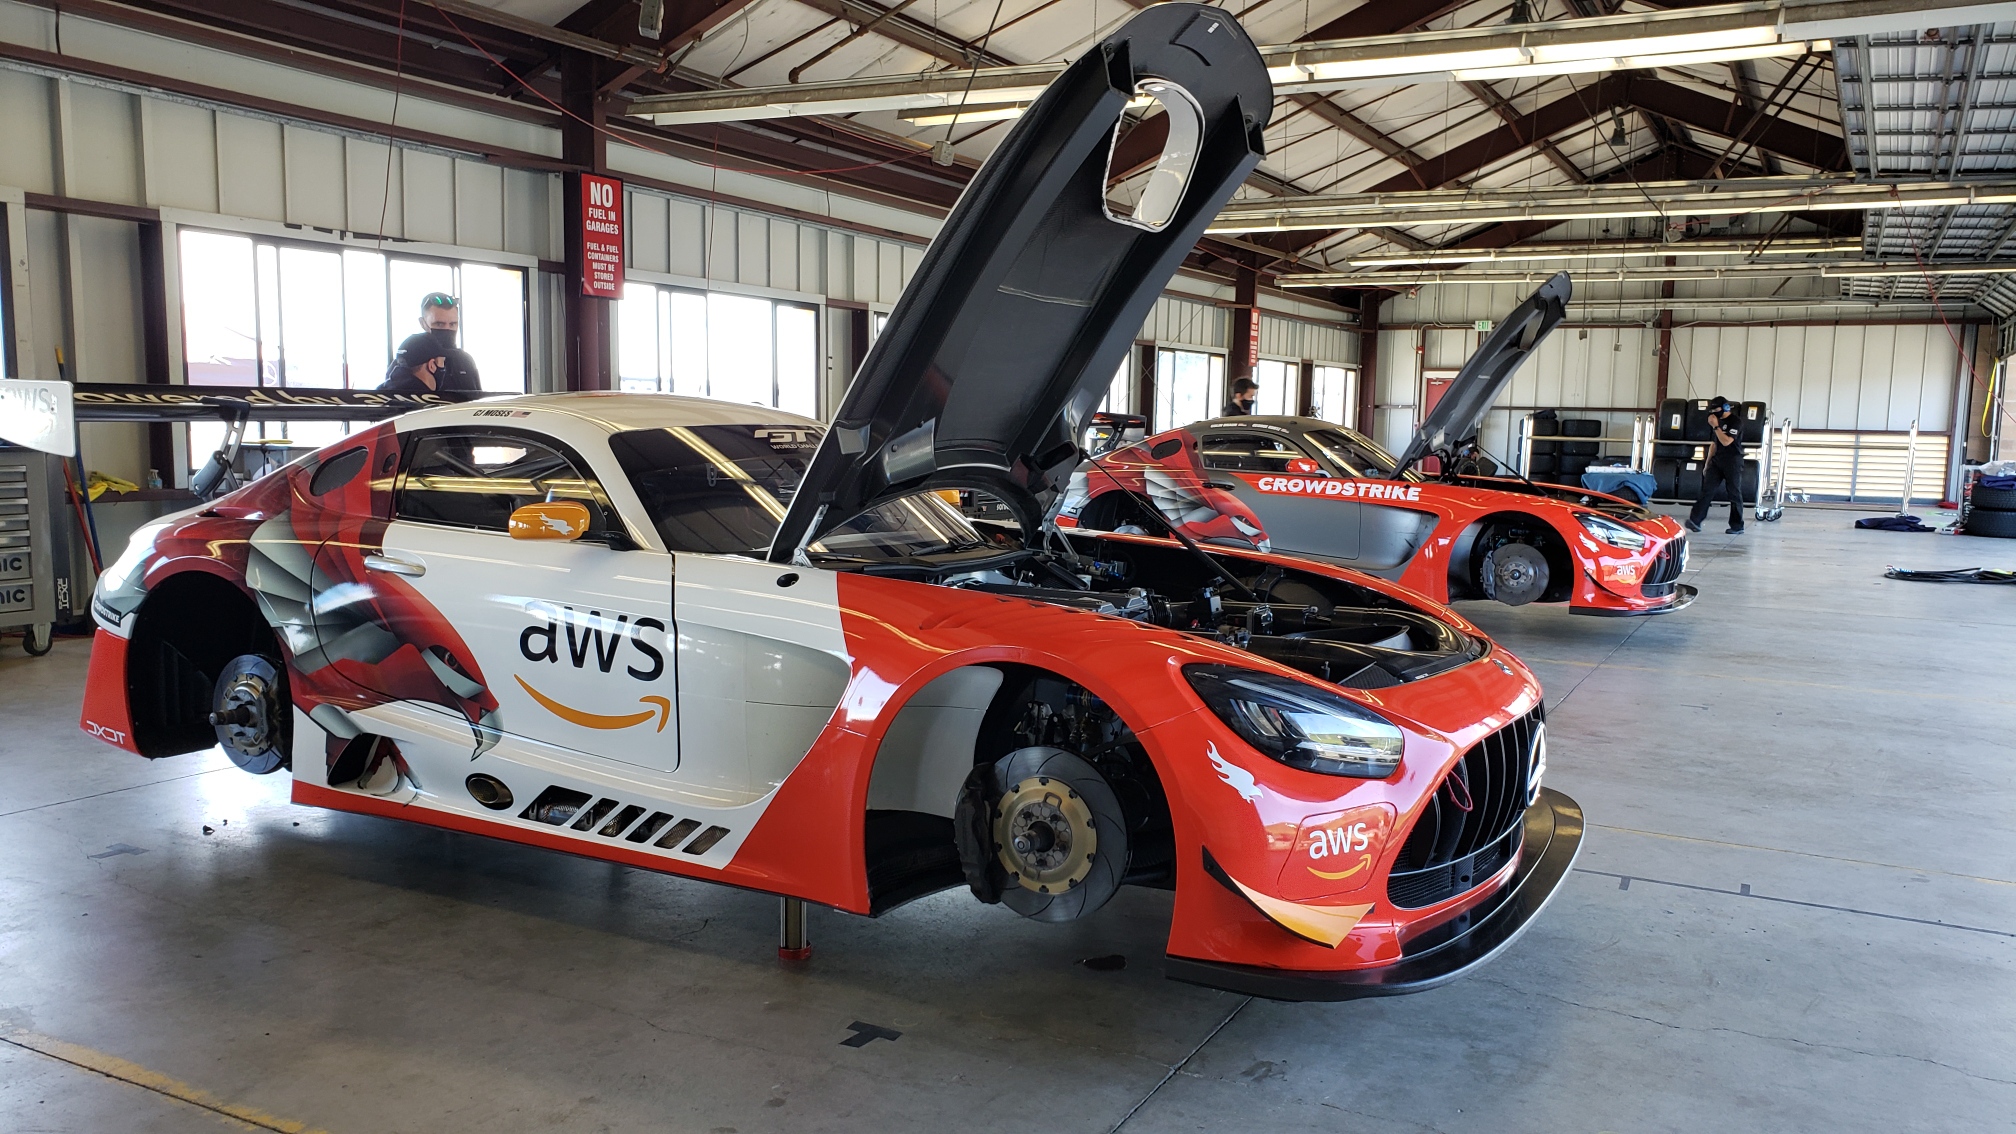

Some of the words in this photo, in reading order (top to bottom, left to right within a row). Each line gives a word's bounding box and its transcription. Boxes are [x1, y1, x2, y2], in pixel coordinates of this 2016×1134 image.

[590, 181, 614, 208] NO
[588, 207, 607, 220] FUEL
[608, 210, 616, 222] IN
[586, 219, 619, 235] GARAGES
[586, 241, 601, 251] FUEL
[601, 243, 606, 252] &
[606, 244, 619, 254] FUEL
[587, 251, 619, 263] CONTAINERS
[592, 261, 607, 271] MUST
[607, 263, 615, 272] BE
[593, 271, 614, 281] STORED
[593, 280, 615, 291] OUTSIDE
[482, 409, 514, 417] MOSES
[1258, 477, 1422, 501] CROWDSTRIKE
[1616, 564, 1636, 576] aws
[519, 600, 666, 682] aws
[1309, 822, 1369, 860] aws
